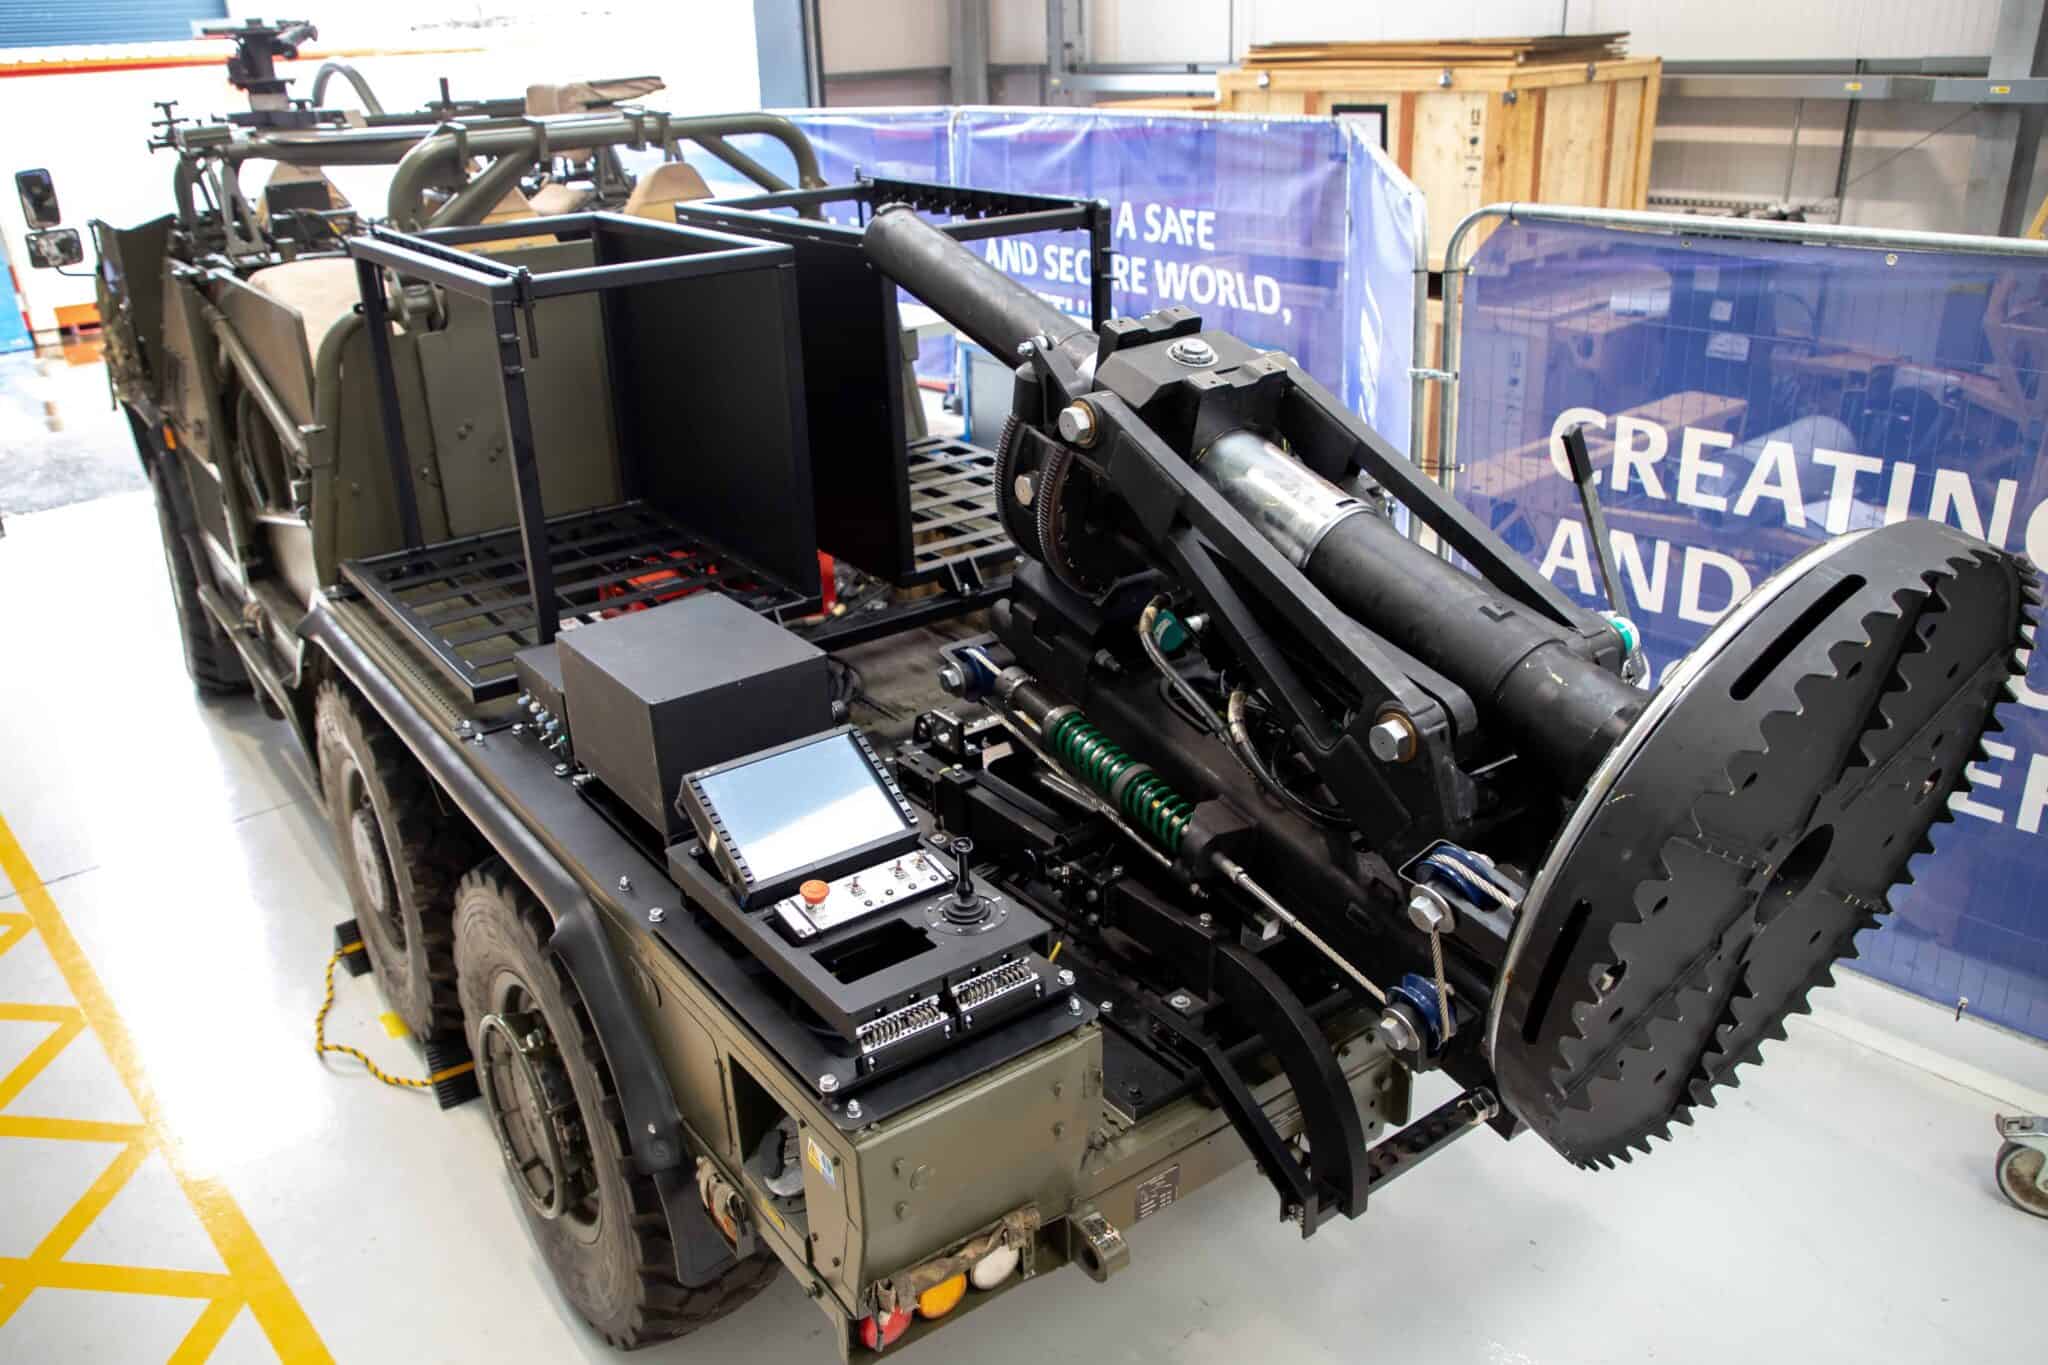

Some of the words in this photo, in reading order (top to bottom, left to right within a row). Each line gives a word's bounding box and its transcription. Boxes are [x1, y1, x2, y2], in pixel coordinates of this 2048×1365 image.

[1116, 200, 1137, 241] A
[1143, 202, 1217, 251] SAFE
[984, 237, 1039, 277] AND
[1043, 244, 1148, 295] SECRE
[1153, 259, 1292, 326] WORLD,
[1538, 517, 1753, 626] AND
